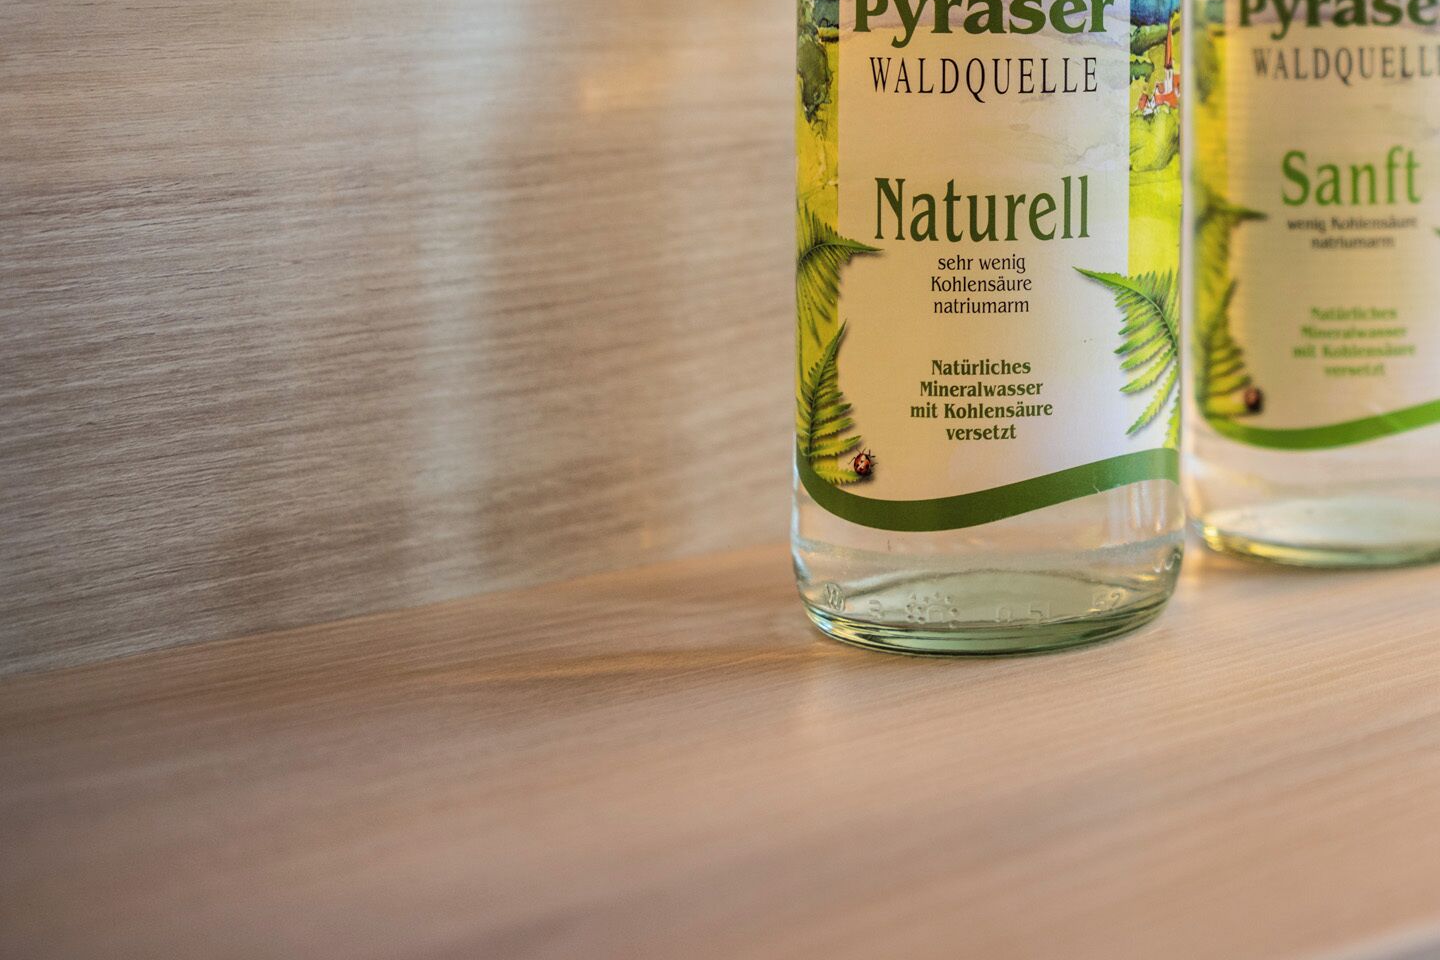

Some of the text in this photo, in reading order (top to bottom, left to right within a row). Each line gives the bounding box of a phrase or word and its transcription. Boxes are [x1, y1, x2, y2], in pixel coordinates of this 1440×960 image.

[869, 56, 1099, 103] WALDQUELLE
[1280, 145, 1423, 208] Sanft
[873, 174, 1091, 243] Naturell
[937, 253, 1026, 274] sehr wenig
[930, 275, 1033, 292] Kohlensäure
[933, 297, 1030, 314] natriumarm
[931, 358, 1032, 376] Natürliches
[919, 380, 1044, 398] Mineralwasser
[910, 401, 1054, 419] mit Kohlensäure
[945, 424, 1017, 441] versetzt
